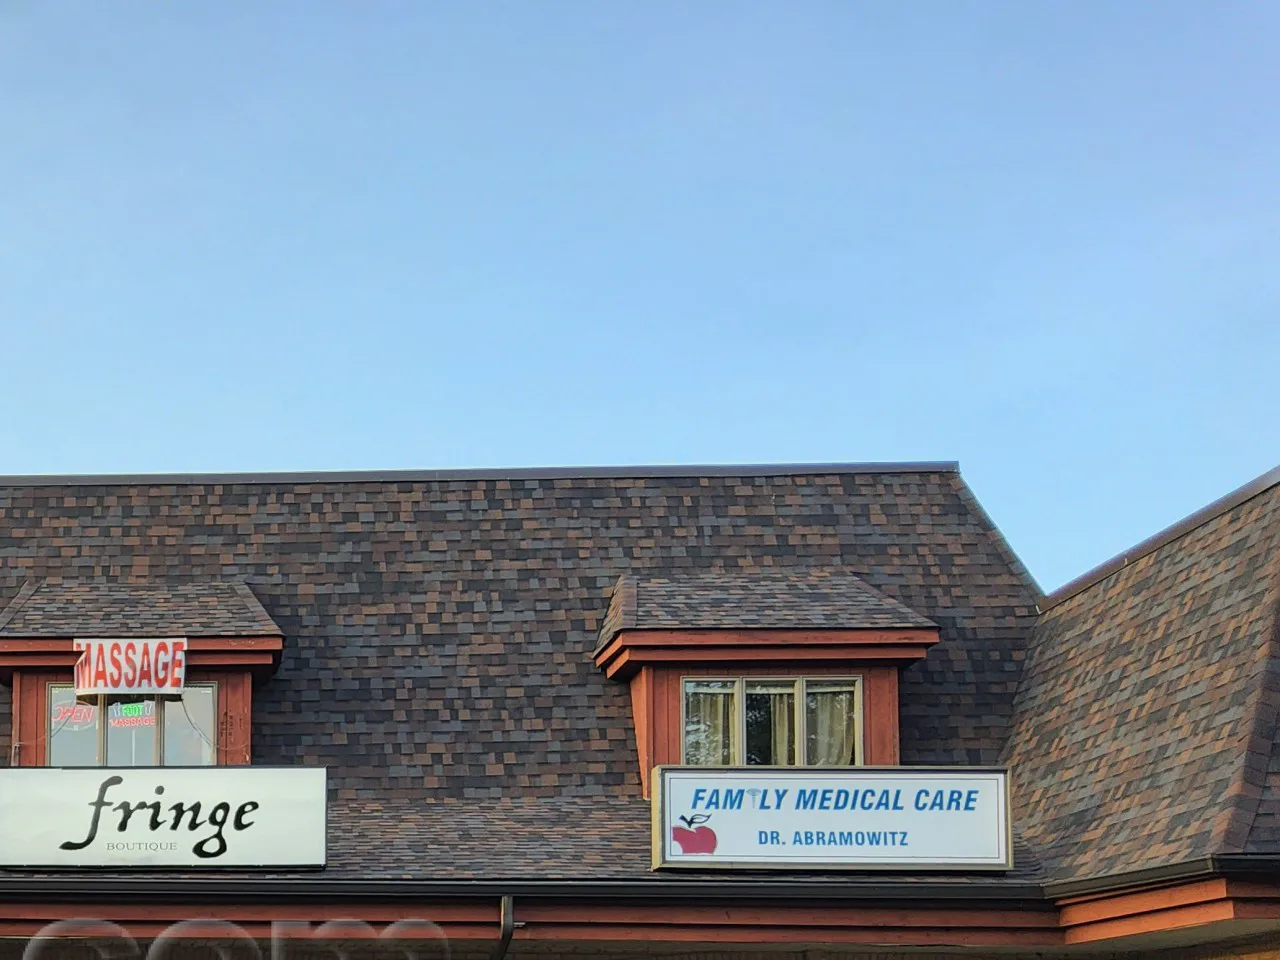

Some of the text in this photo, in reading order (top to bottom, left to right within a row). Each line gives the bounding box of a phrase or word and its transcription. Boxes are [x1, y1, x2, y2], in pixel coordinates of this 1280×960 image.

[75, 641, 185, 689] MASSAGE
[52, 705, 94, 723] OPEN
[121, 703, 144, 717] FOOT
[109, 716, 156, 728] MASSAGE
[794, 788, 904, 811] MEDICAL
[913, 789, 979, 812] CARE
[58, 775, 259, 858] fringe
[106, 842, 178, 851] BOUTIQUE
[758, 830, 909, 847] DR. ABRAMOWITZ
